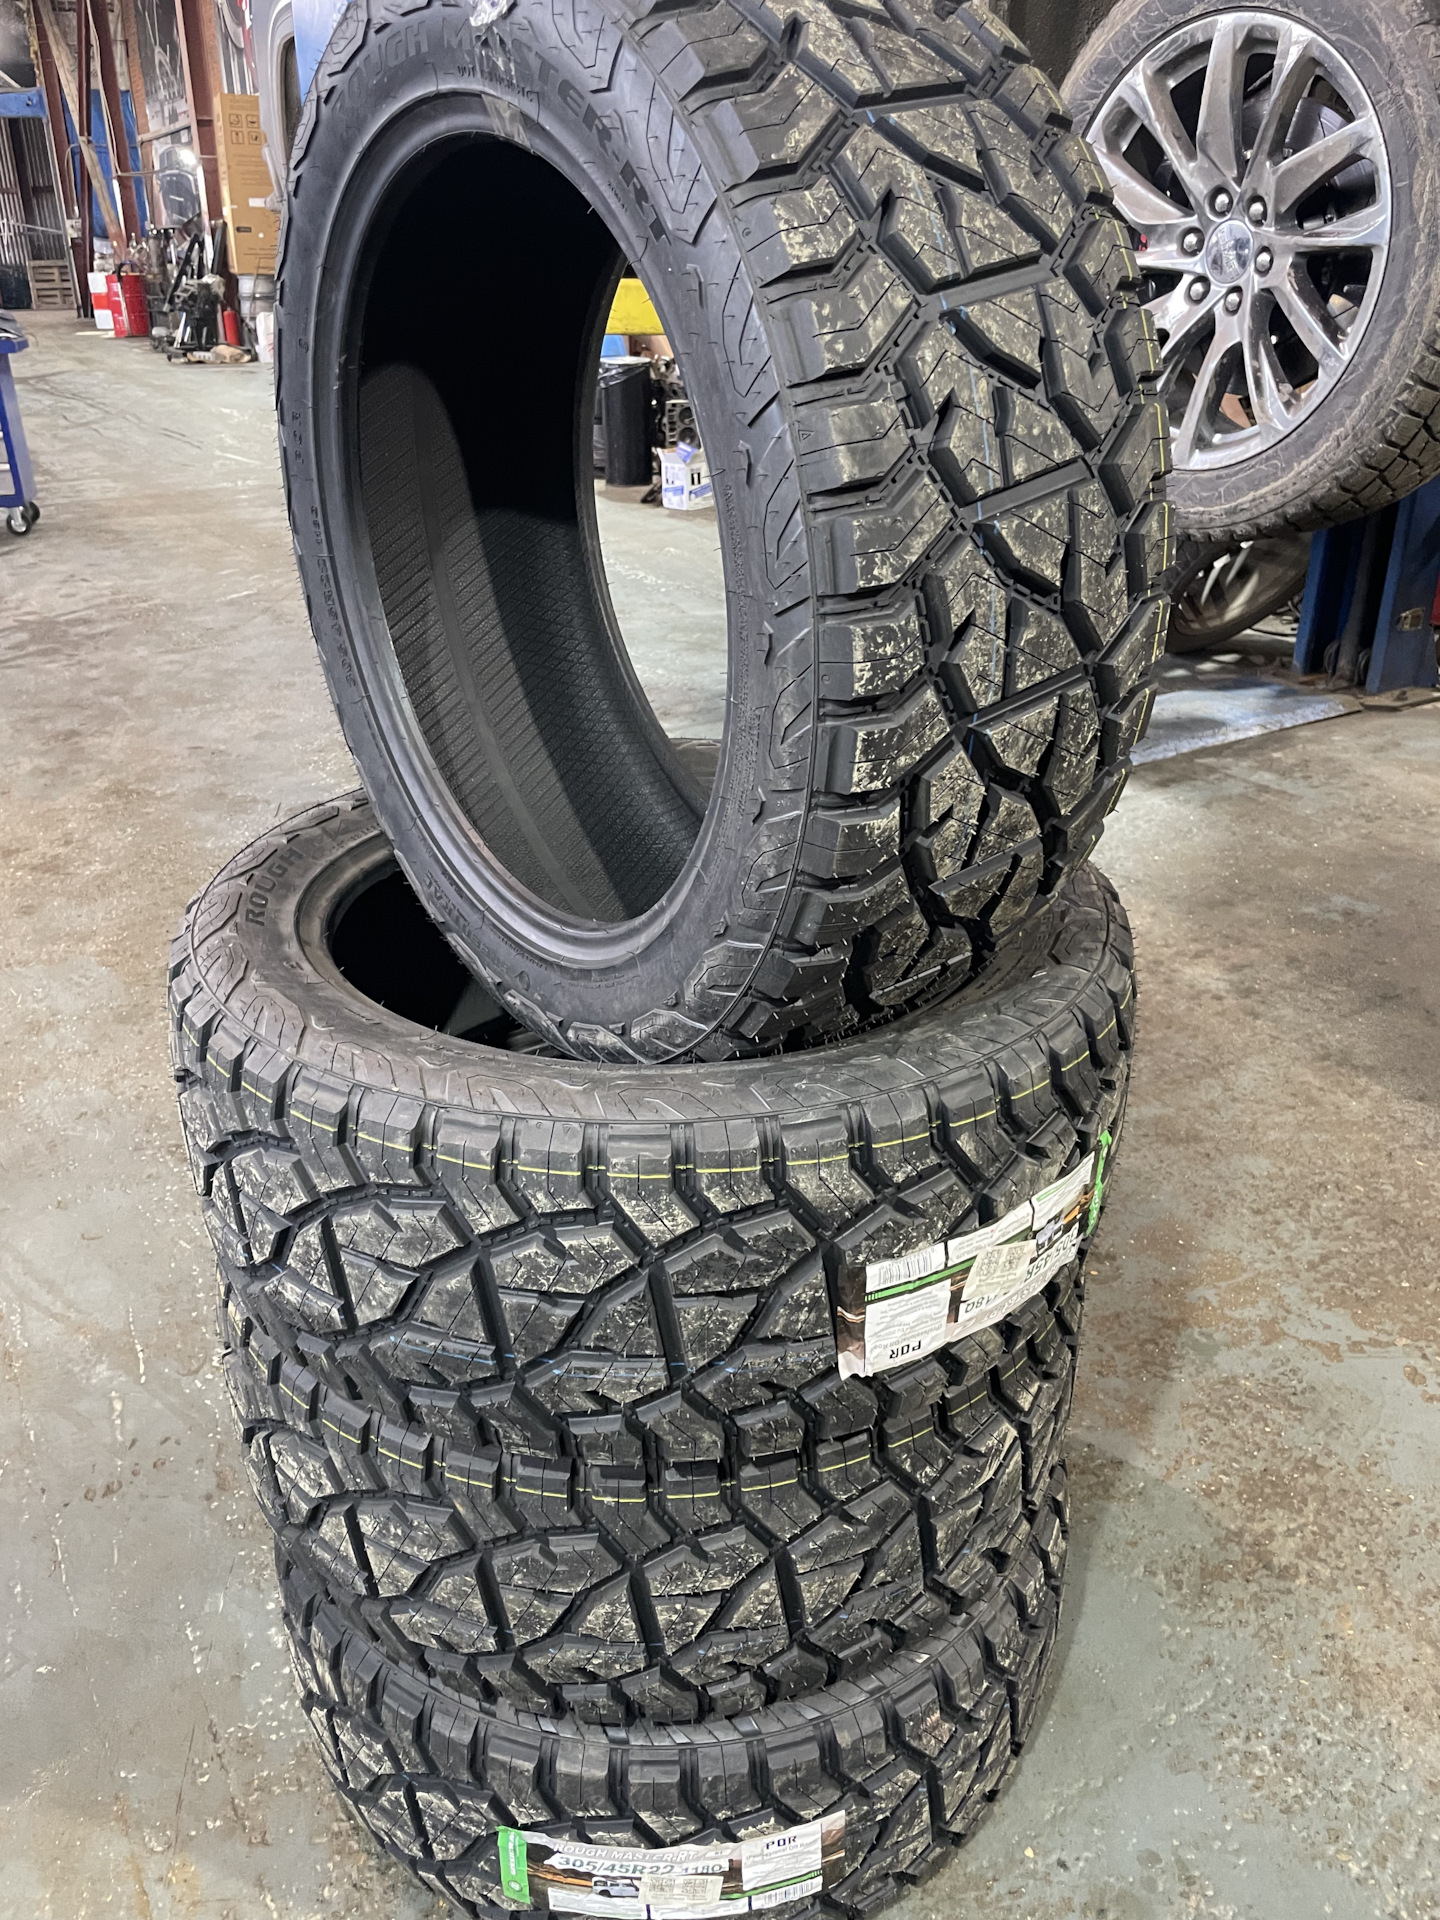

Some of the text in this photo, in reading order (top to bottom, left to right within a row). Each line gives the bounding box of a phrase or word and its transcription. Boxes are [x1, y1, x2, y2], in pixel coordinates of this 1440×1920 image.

[442, 16, 673, 246] MSTER-RT
[245, 847, 304, 927] ROUGH
[889, 1339, 922, 1359] POR
[553, 1843, 607, 1859] ROUGH
[766, 1835, 797, 1850] POR
[558, 1856, 675, 1875] 305/45R22
